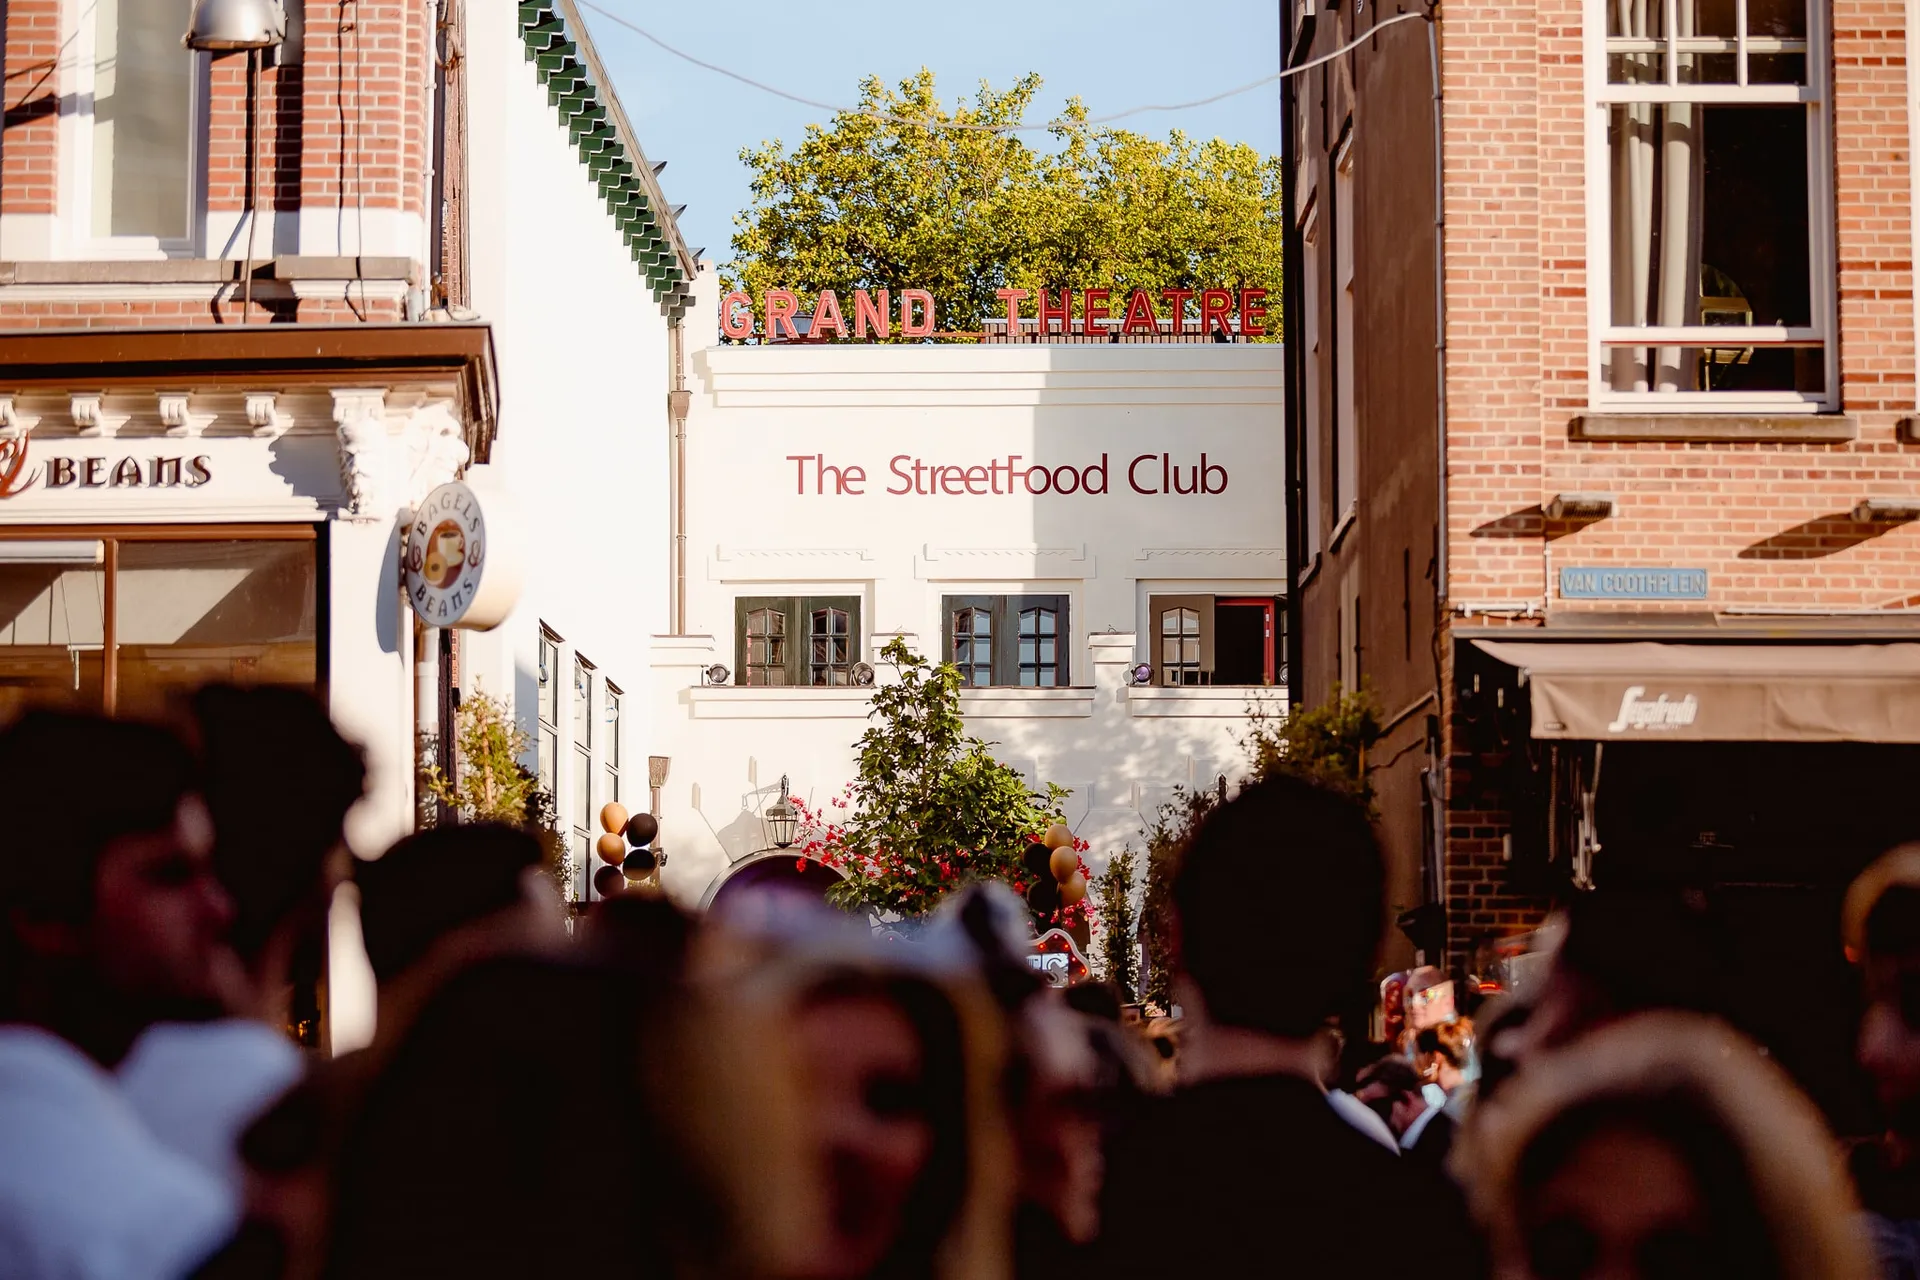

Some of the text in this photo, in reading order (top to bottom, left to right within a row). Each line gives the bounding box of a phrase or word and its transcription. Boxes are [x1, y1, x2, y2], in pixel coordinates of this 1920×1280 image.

[720, 288, 1268, 339] GRAND THEATRE
[786, 453, 1229, 495] The StreetFood Club
[416, 492, 480, 537] BAGELS
[1563, 573, 1705, 594] VAN COOTHPLEIN
